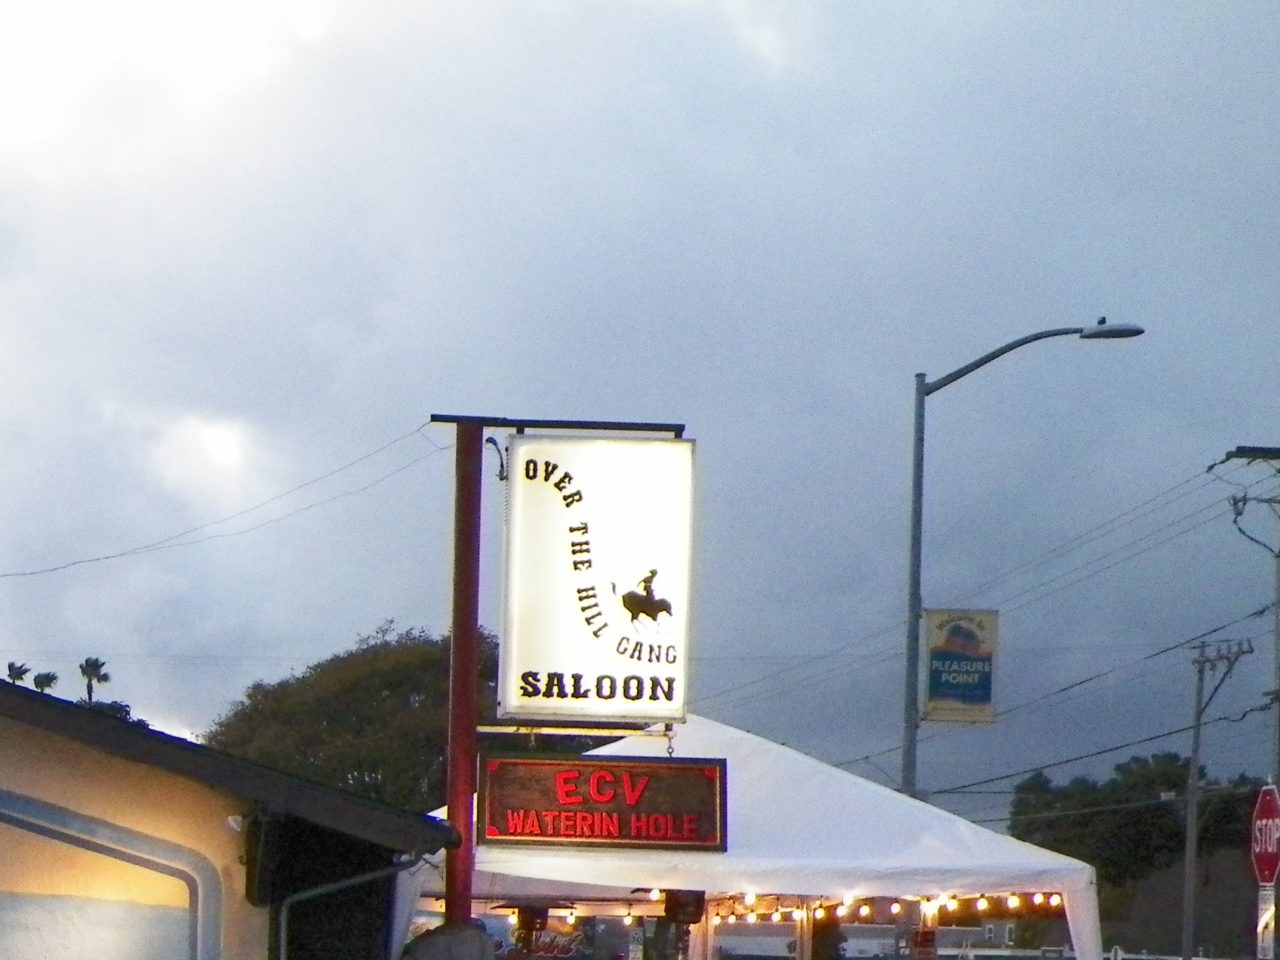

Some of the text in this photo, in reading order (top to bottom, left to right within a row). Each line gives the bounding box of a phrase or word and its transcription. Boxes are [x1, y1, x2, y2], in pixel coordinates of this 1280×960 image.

[524, 458, 678, 665] OVER THE HILL GANG
[931, 660, 991, 671] PLEASURE
[941, 672, 980, 684] POINT
[519, 671, 677, 702] SALOON
[553, 770, 651, 806] ECV
[506, 810, 701, 839] WATERIN HOLE
[1255, 818, 1280, 853] STOP
